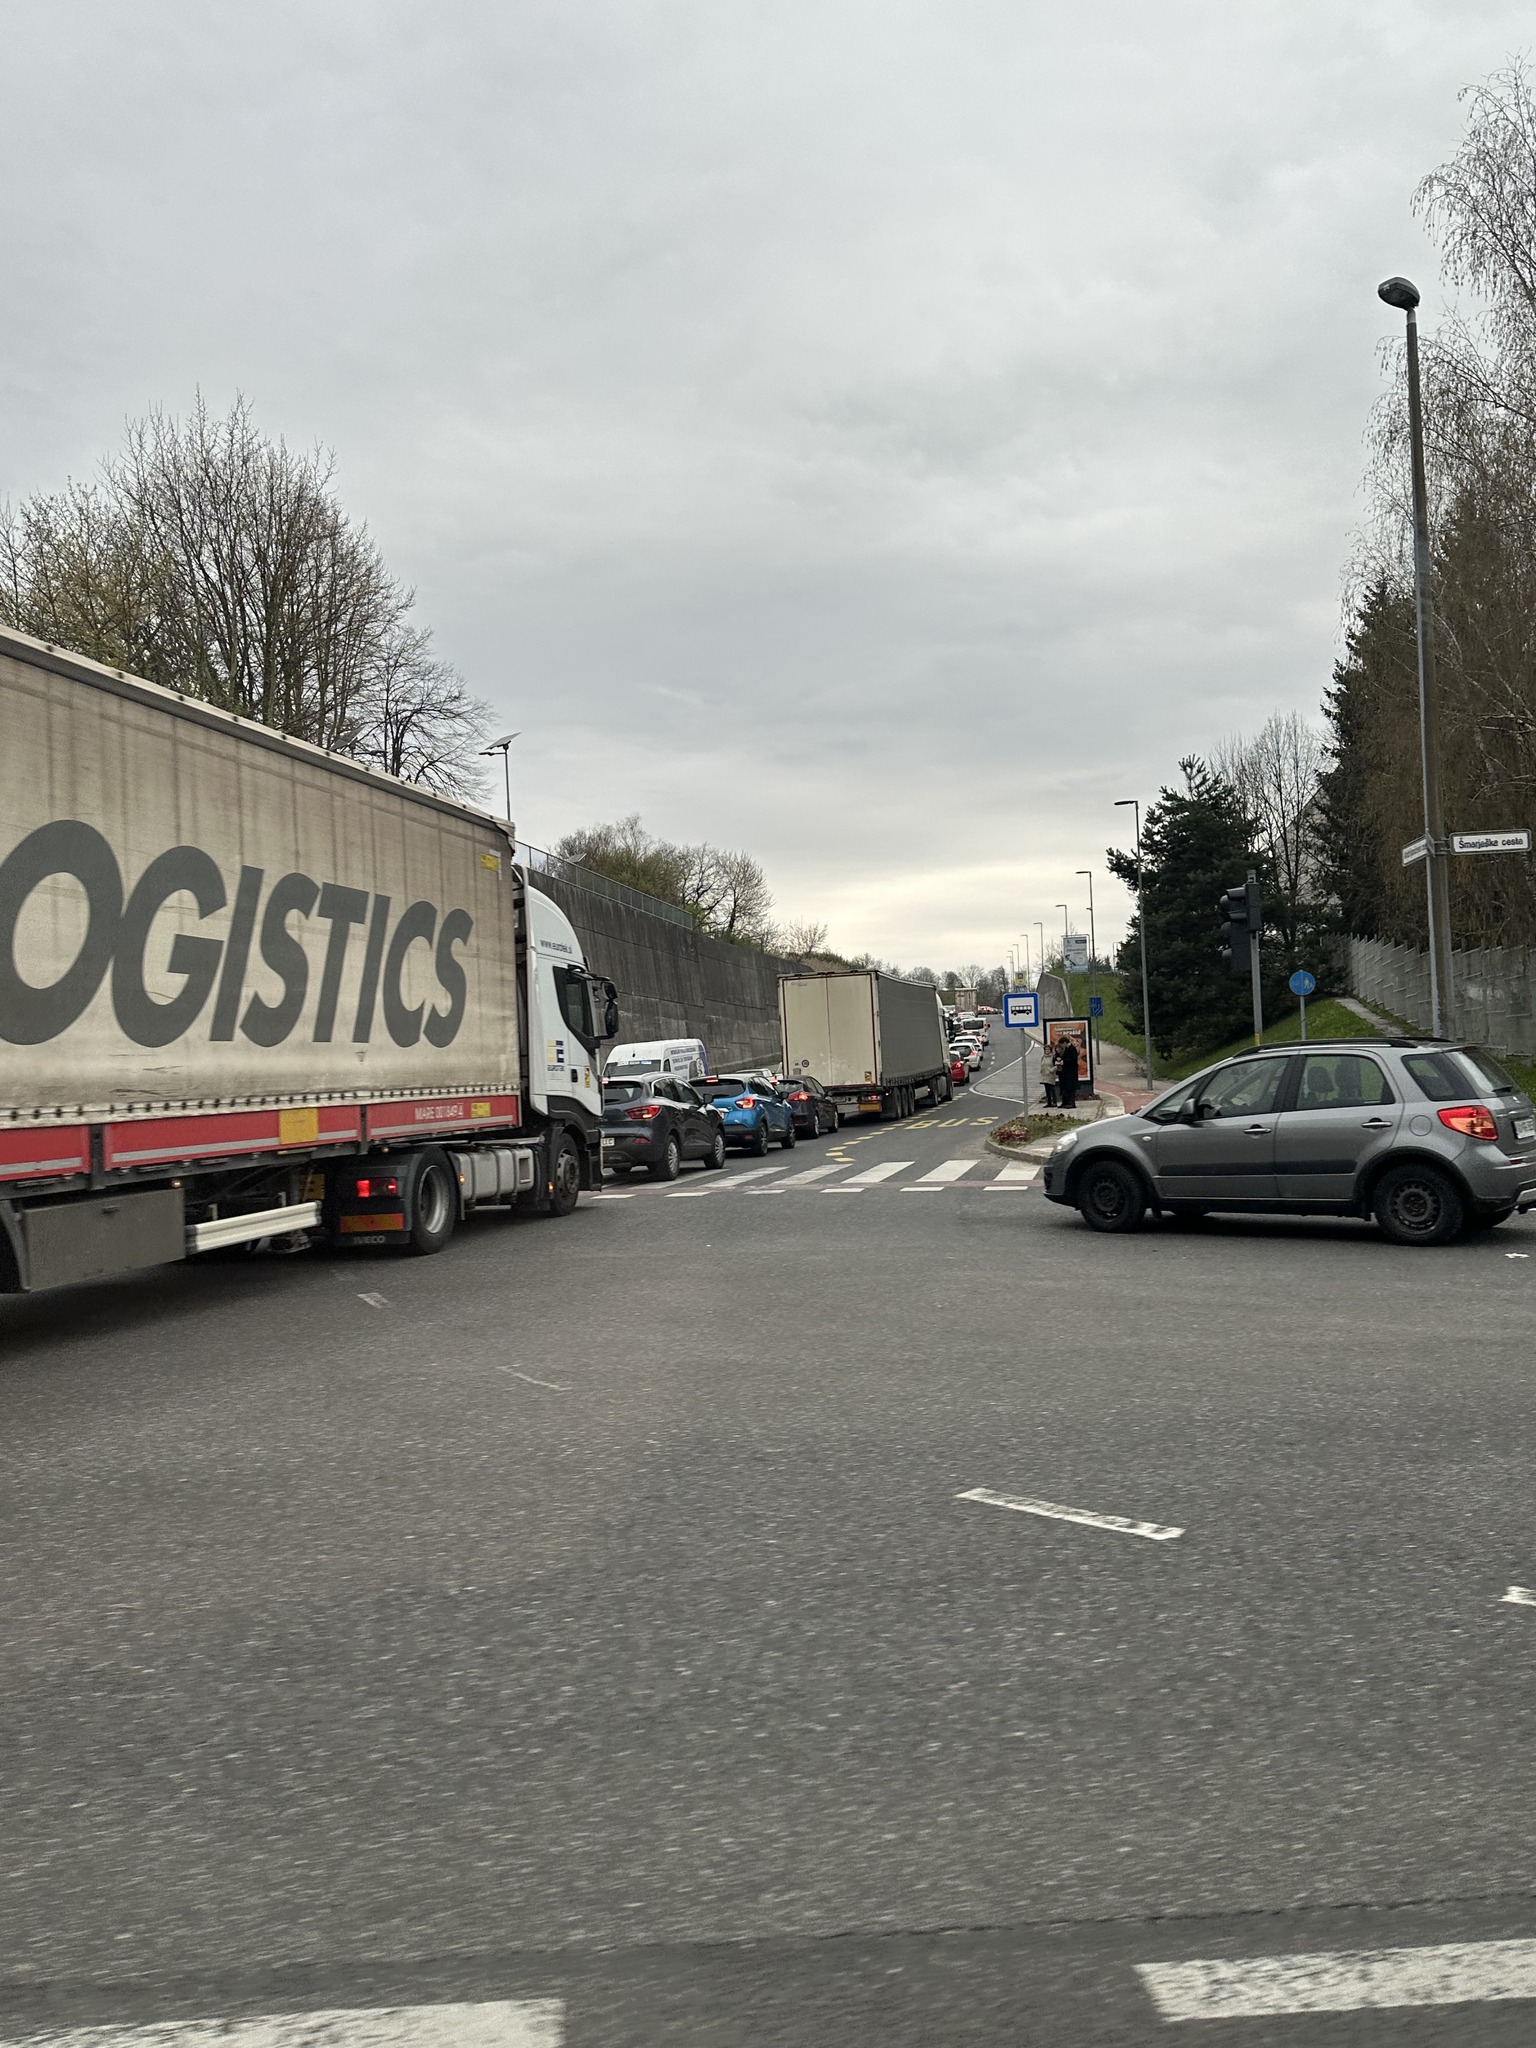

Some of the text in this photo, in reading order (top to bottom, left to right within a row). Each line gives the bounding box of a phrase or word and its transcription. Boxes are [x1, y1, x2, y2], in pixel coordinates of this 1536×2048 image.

[1501, 837, 1524, 847] cesta
[0, 819, 474, 1048] OGISTICS
[904, 1116, 999, 1130] BUS
